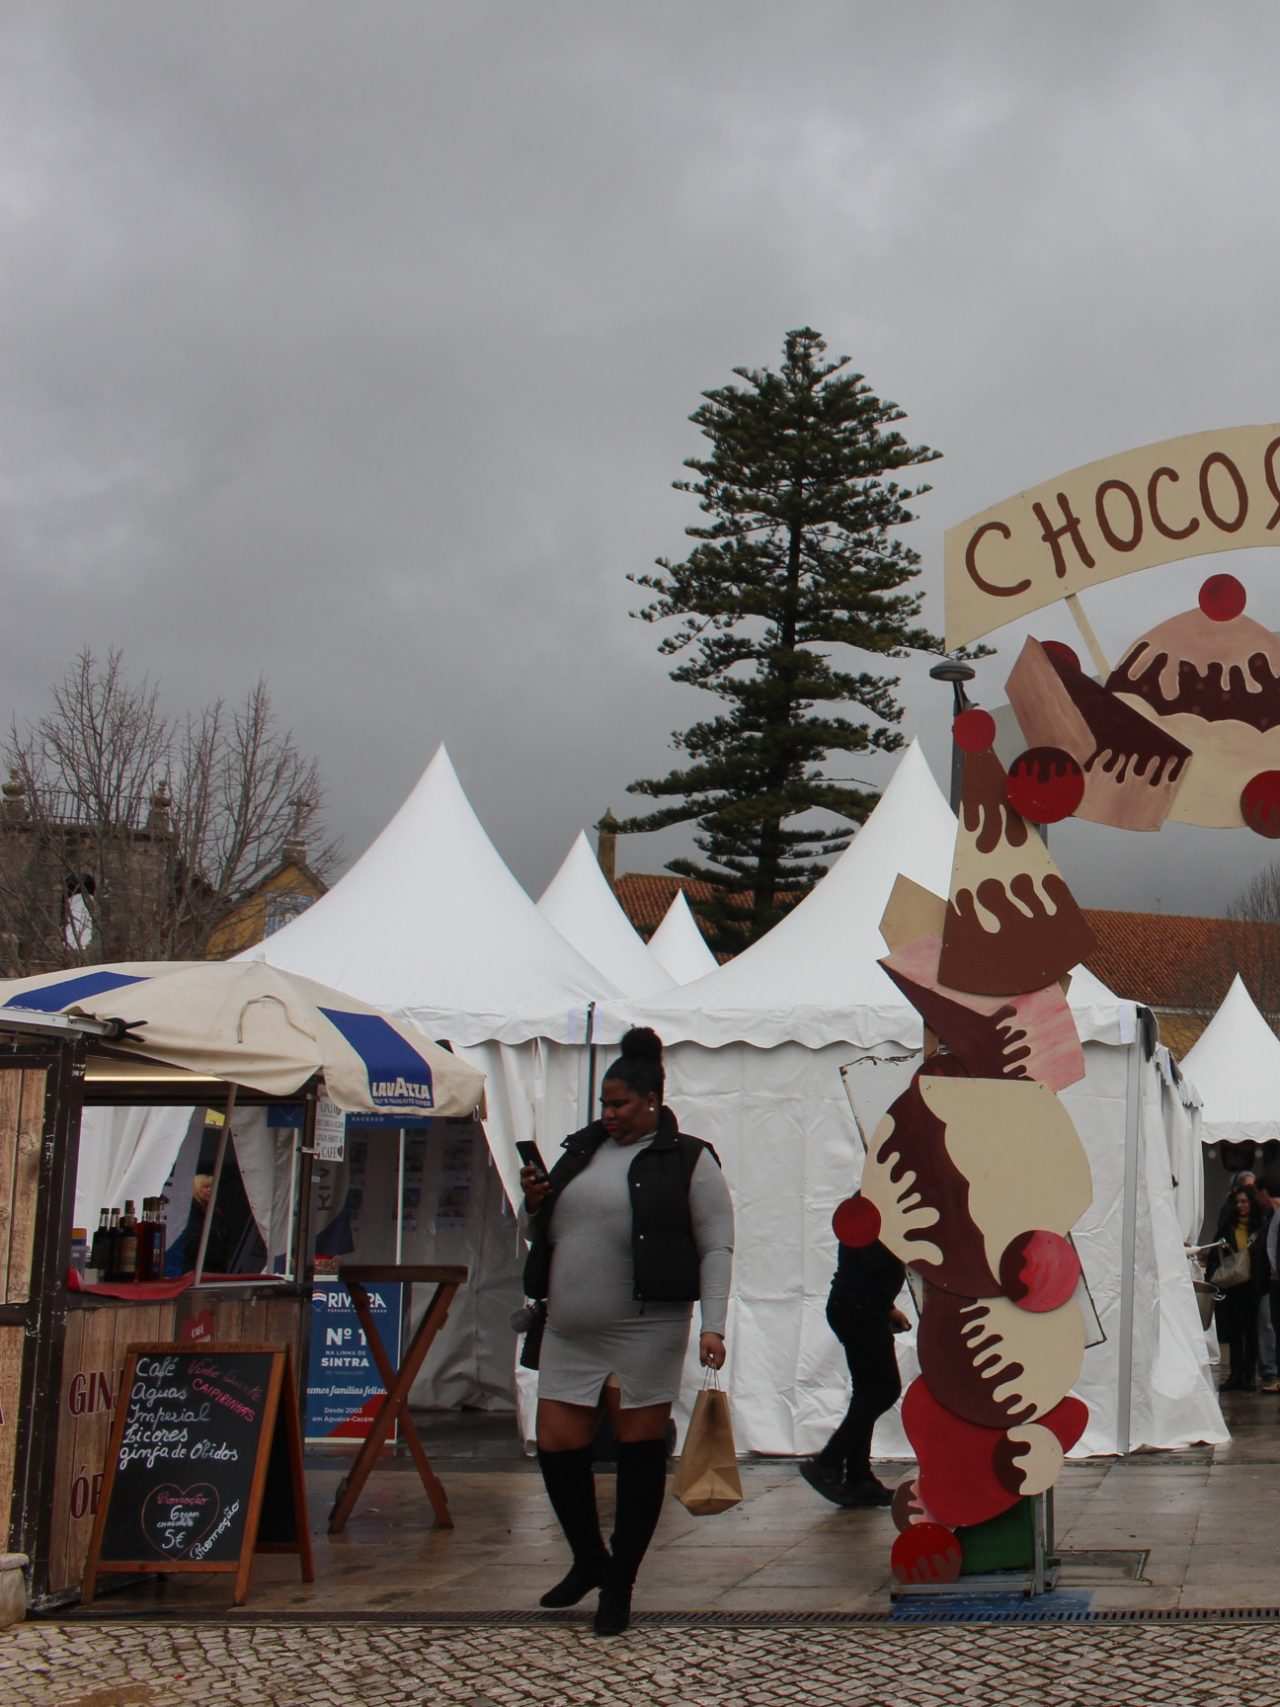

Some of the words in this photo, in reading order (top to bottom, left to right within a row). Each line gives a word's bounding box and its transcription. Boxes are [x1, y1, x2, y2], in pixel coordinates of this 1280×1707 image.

[372, 1077, 431, 1100] LAVAZZA
[328, 1292, 387, 1308] RIVRA
[358, 1327, 367, 1346] 1
[135, 1356, 180, 1387] Café
[321, 1357, 370, 1368] SINTRA
[68, 1369, 125, 1417] GIN
[127, 1402, 211, 1432] Imperial
[122, 1423, 189, 1444] Licores
[171, 1443, 187, 1458] de
[162, 1528, 187, 1549] 5€
